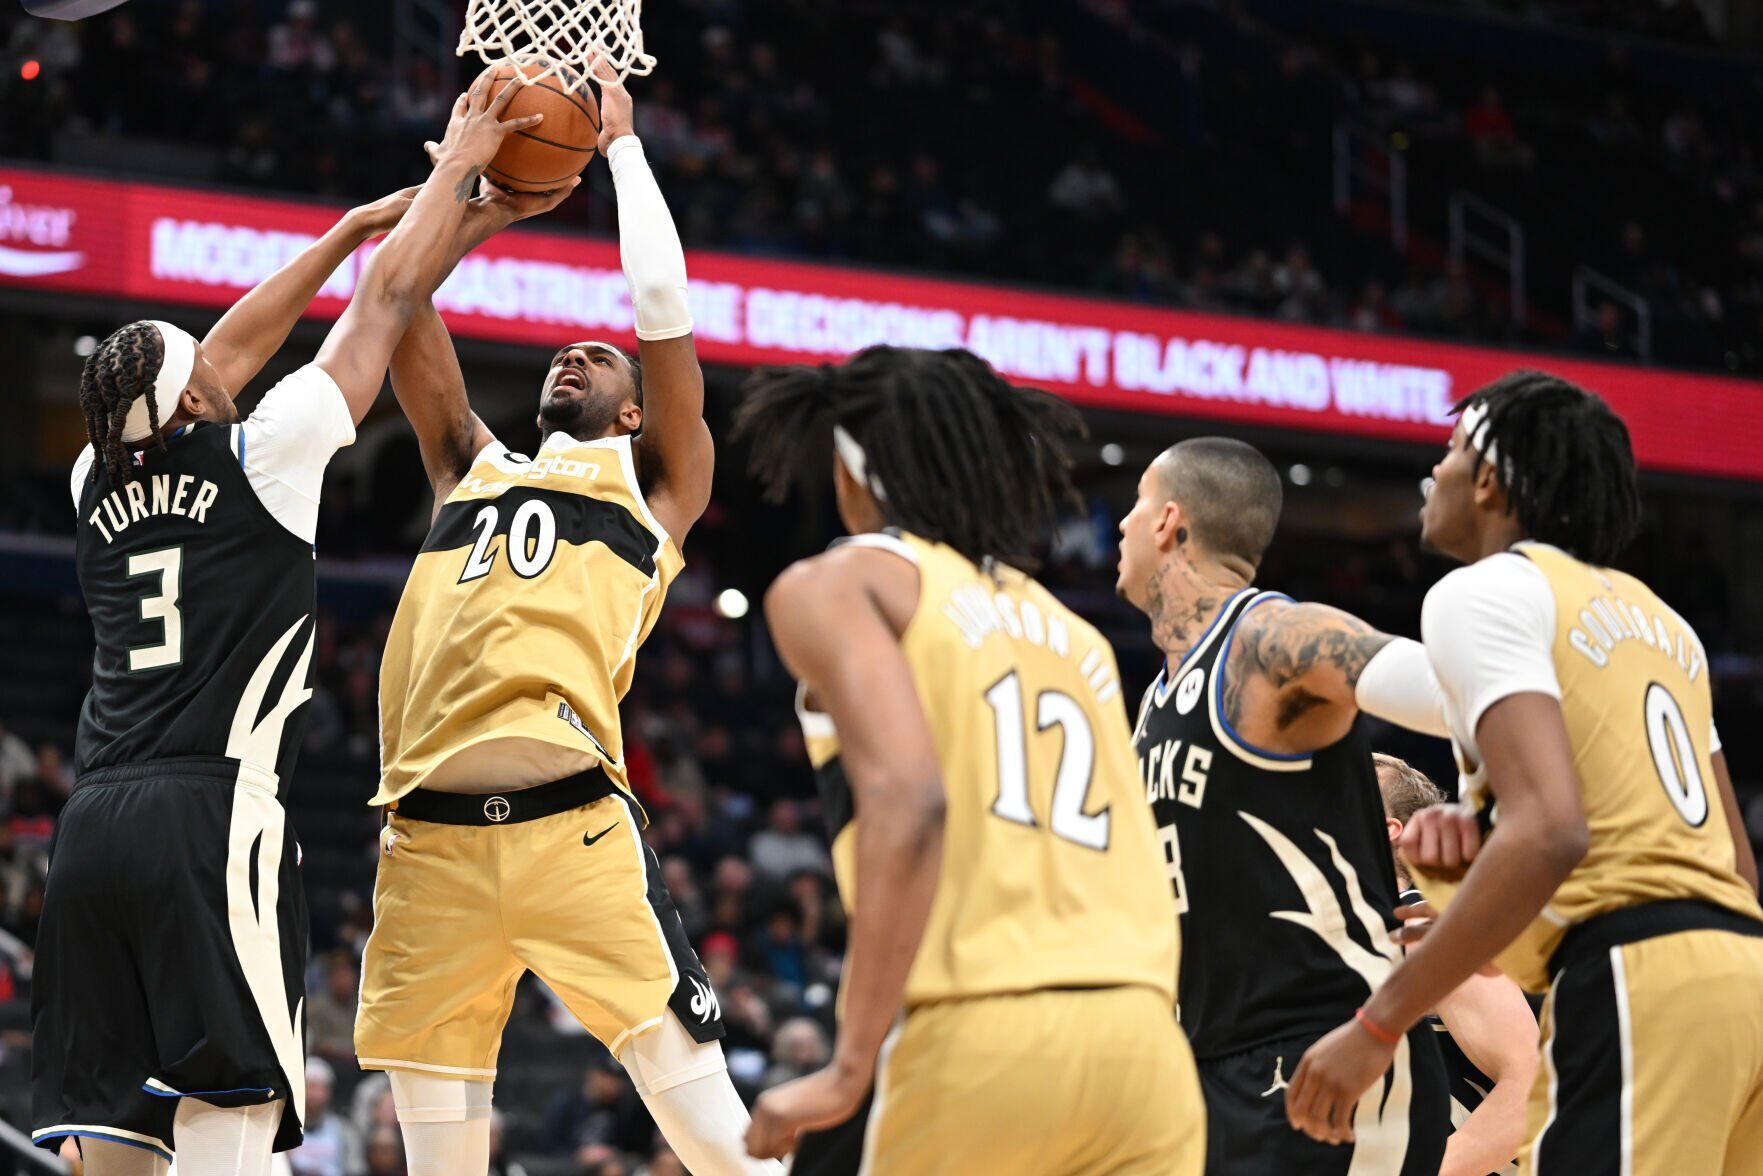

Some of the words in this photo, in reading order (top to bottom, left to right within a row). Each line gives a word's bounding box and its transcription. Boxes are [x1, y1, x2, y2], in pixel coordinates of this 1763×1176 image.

[1113, 330, 1247, 402] BLACK
[1243, 345, 1330, 412] AND
[88, 474, 218, 544] TURNER
[457, 498, 557, 585] 20
[127, 544, 184, 673] 3
[983, 667, 1111, 853] 12
[1139, 739, 1213, 809] CKS
[1644, 680, 1708, 827] 0
